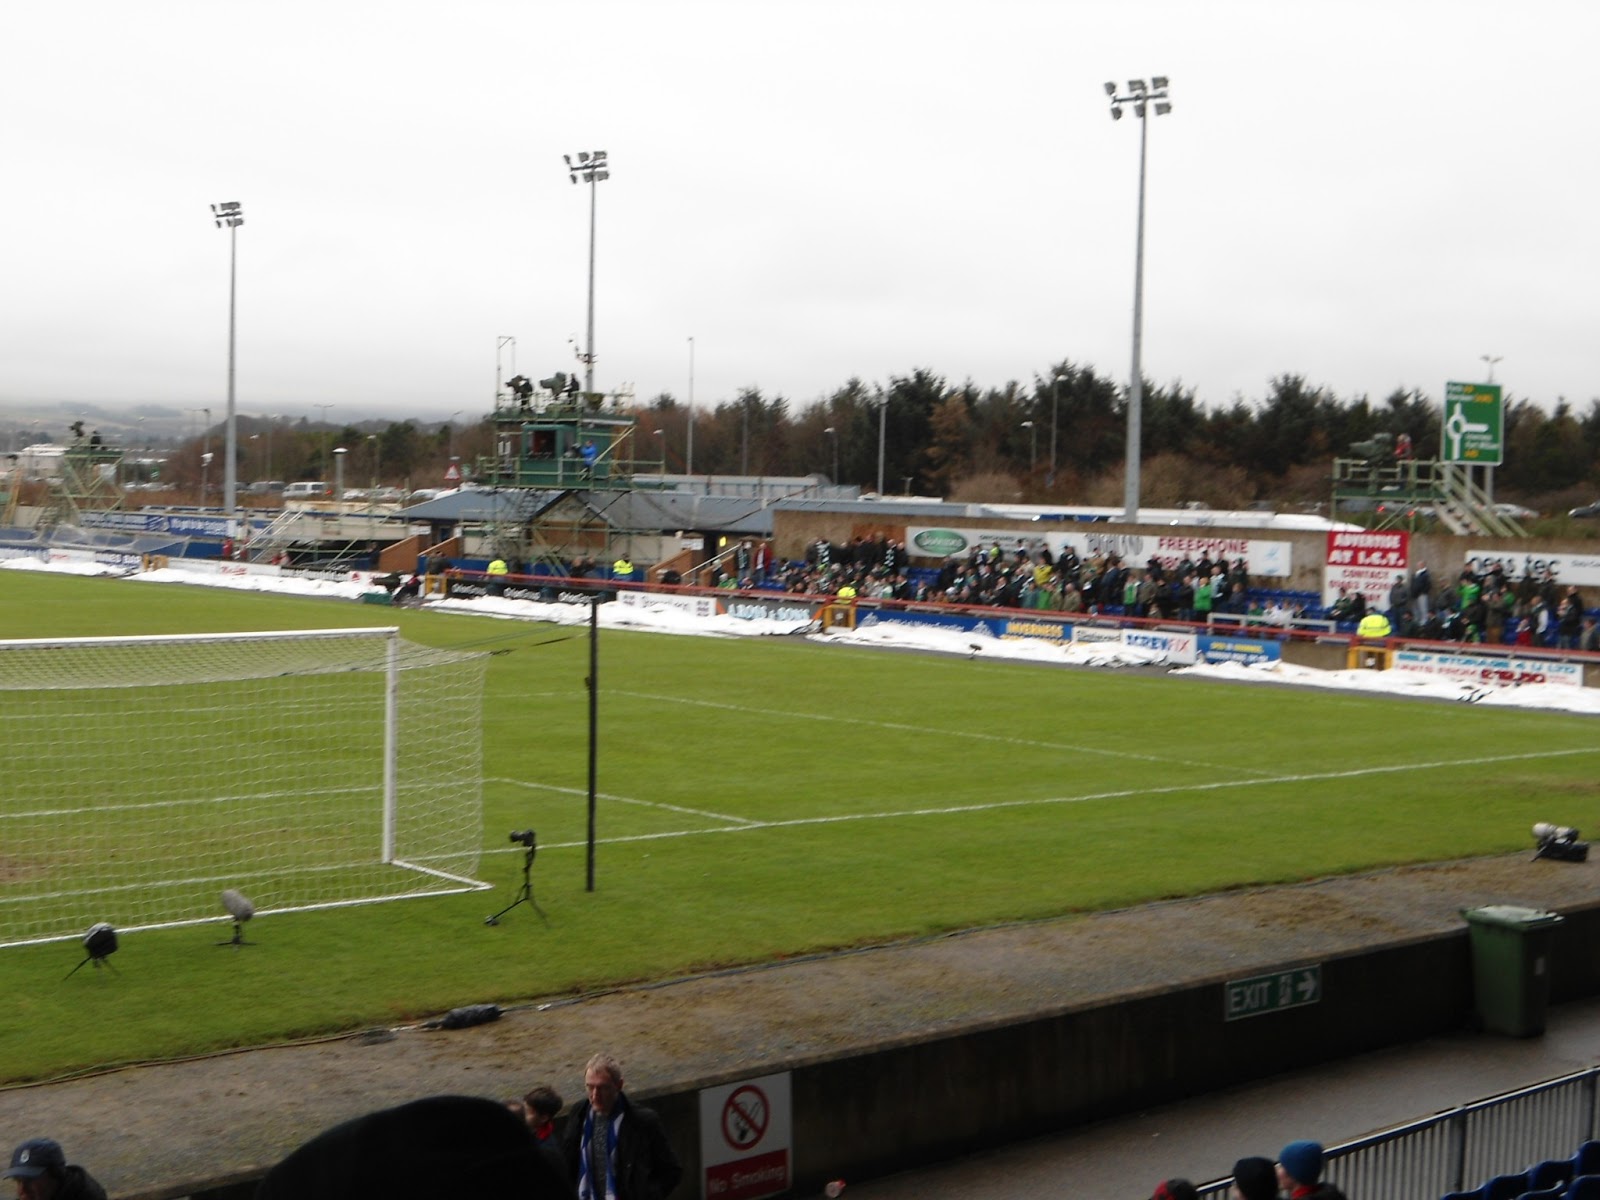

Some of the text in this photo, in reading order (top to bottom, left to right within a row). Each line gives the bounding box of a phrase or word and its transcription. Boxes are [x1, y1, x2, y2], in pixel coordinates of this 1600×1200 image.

[1158, 535, 1249, 554] FREEPHONE
[1333, 533, 1401, 549] ADVERTISE
[1328, 550, 1354, 564] AT
[1342, 569, 1390, 580] CONTACT
[1126, 633, 1191, 653] SCREWFIX
[1231, 982, 1271, 1012] EXIT
[709, 1166, 785, 1194] No Smoking
